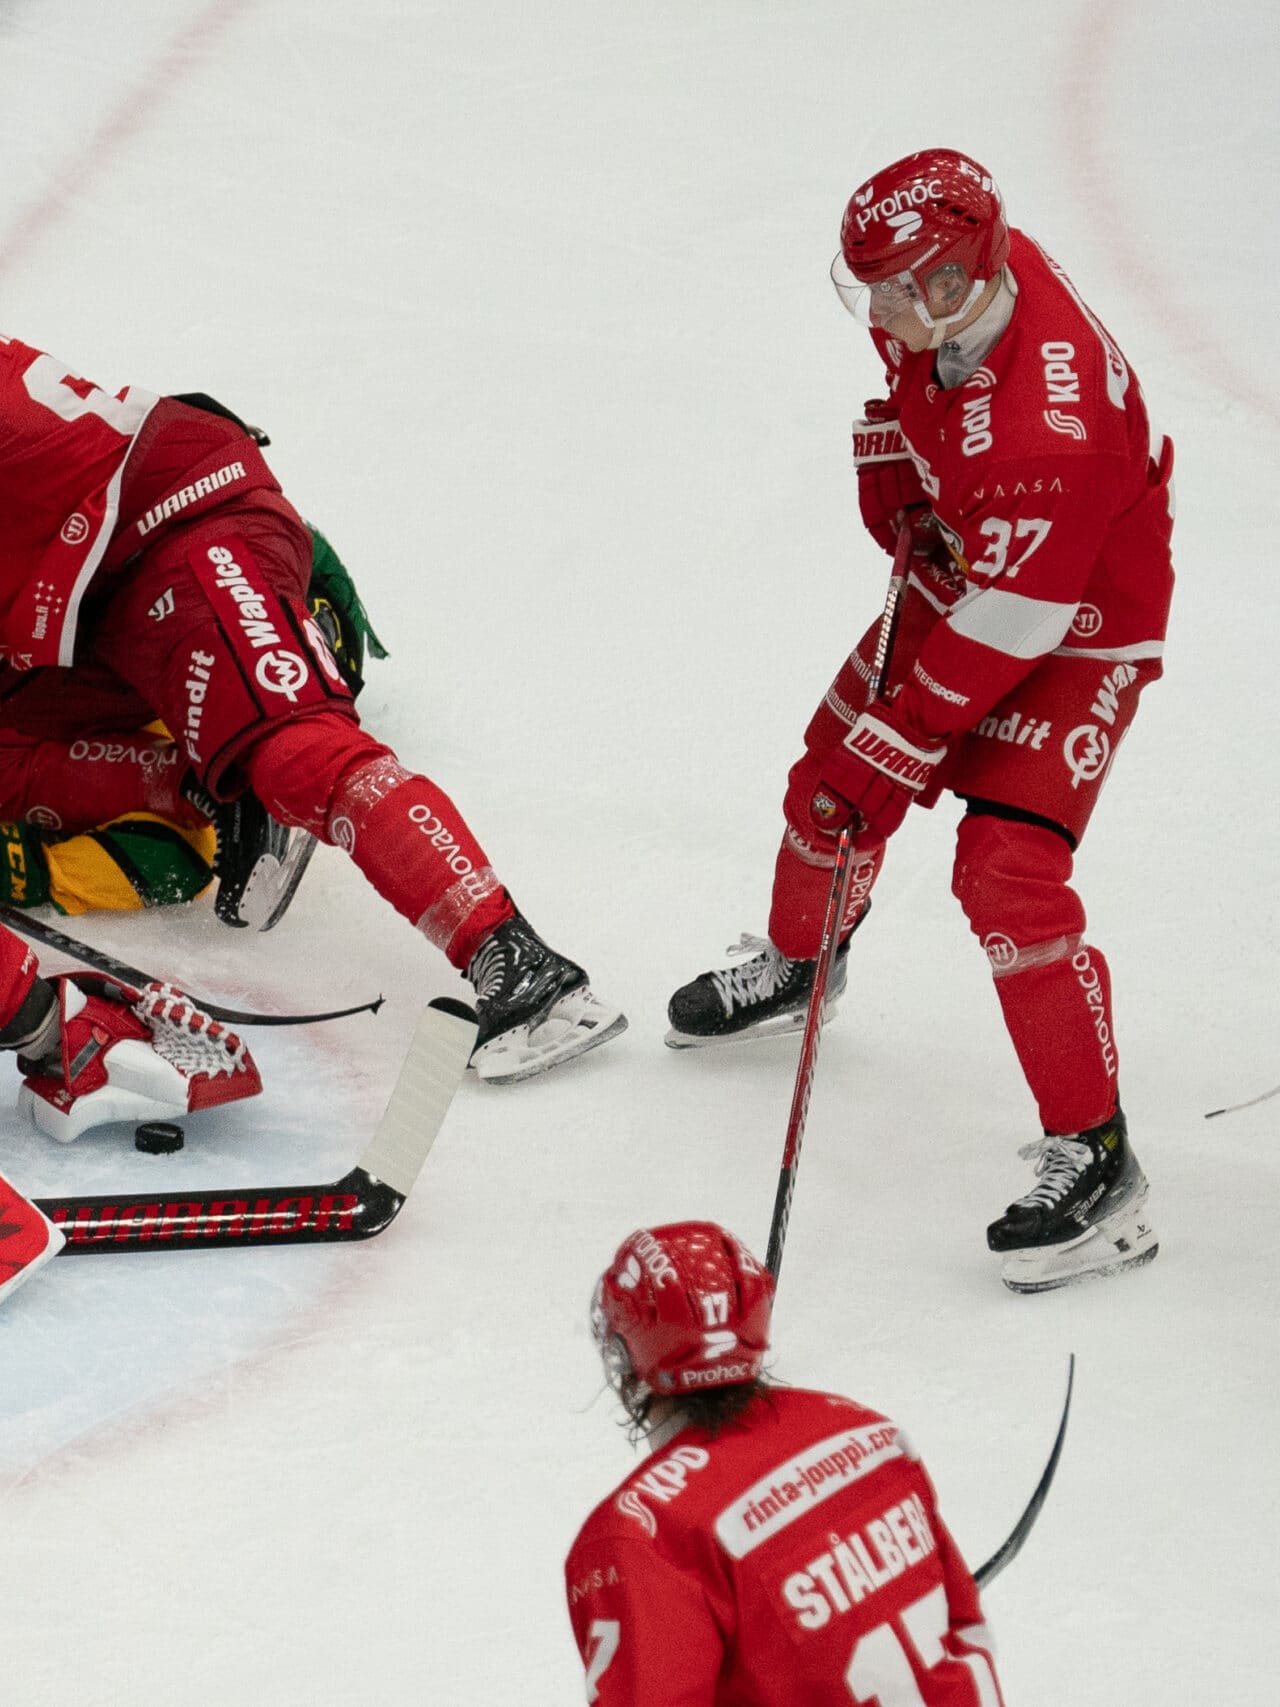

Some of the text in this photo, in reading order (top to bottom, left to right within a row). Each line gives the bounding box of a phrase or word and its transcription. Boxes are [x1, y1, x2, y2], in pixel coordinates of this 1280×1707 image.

[855, 178, 944, 233] Prohoc
[1040, 341, 1081, 403] KPO
[961, 393, 994, 457] KPO
[136, 461, 247, 537] WARRIOR
[974, 477, 1063, 499] VAASA
[971, 516, 1053, 579] 37
[207, 545, 281, 649] Wapice
[183, 649, 216, 763] Findit
[914, 657, 971, 708] NTERSPORT
[973, 711, 1053, 751] ndit
[407, 803, 492, 903] movaco
[1071, 948, 1117, 1077] movaco
[51, 1194, 359, 1245] WARRIOR
[702, 1291, 730, 1327] 17
[681, 1363, 750, 1385] Prohoc
[635, 1445, 710, 1503] KPO
[742, 1425, 900, 1533] rinta-jouppi.co
[781, 1492, 937, 1631] STÅLBER
[584, 1618, 621, 1704] 7
